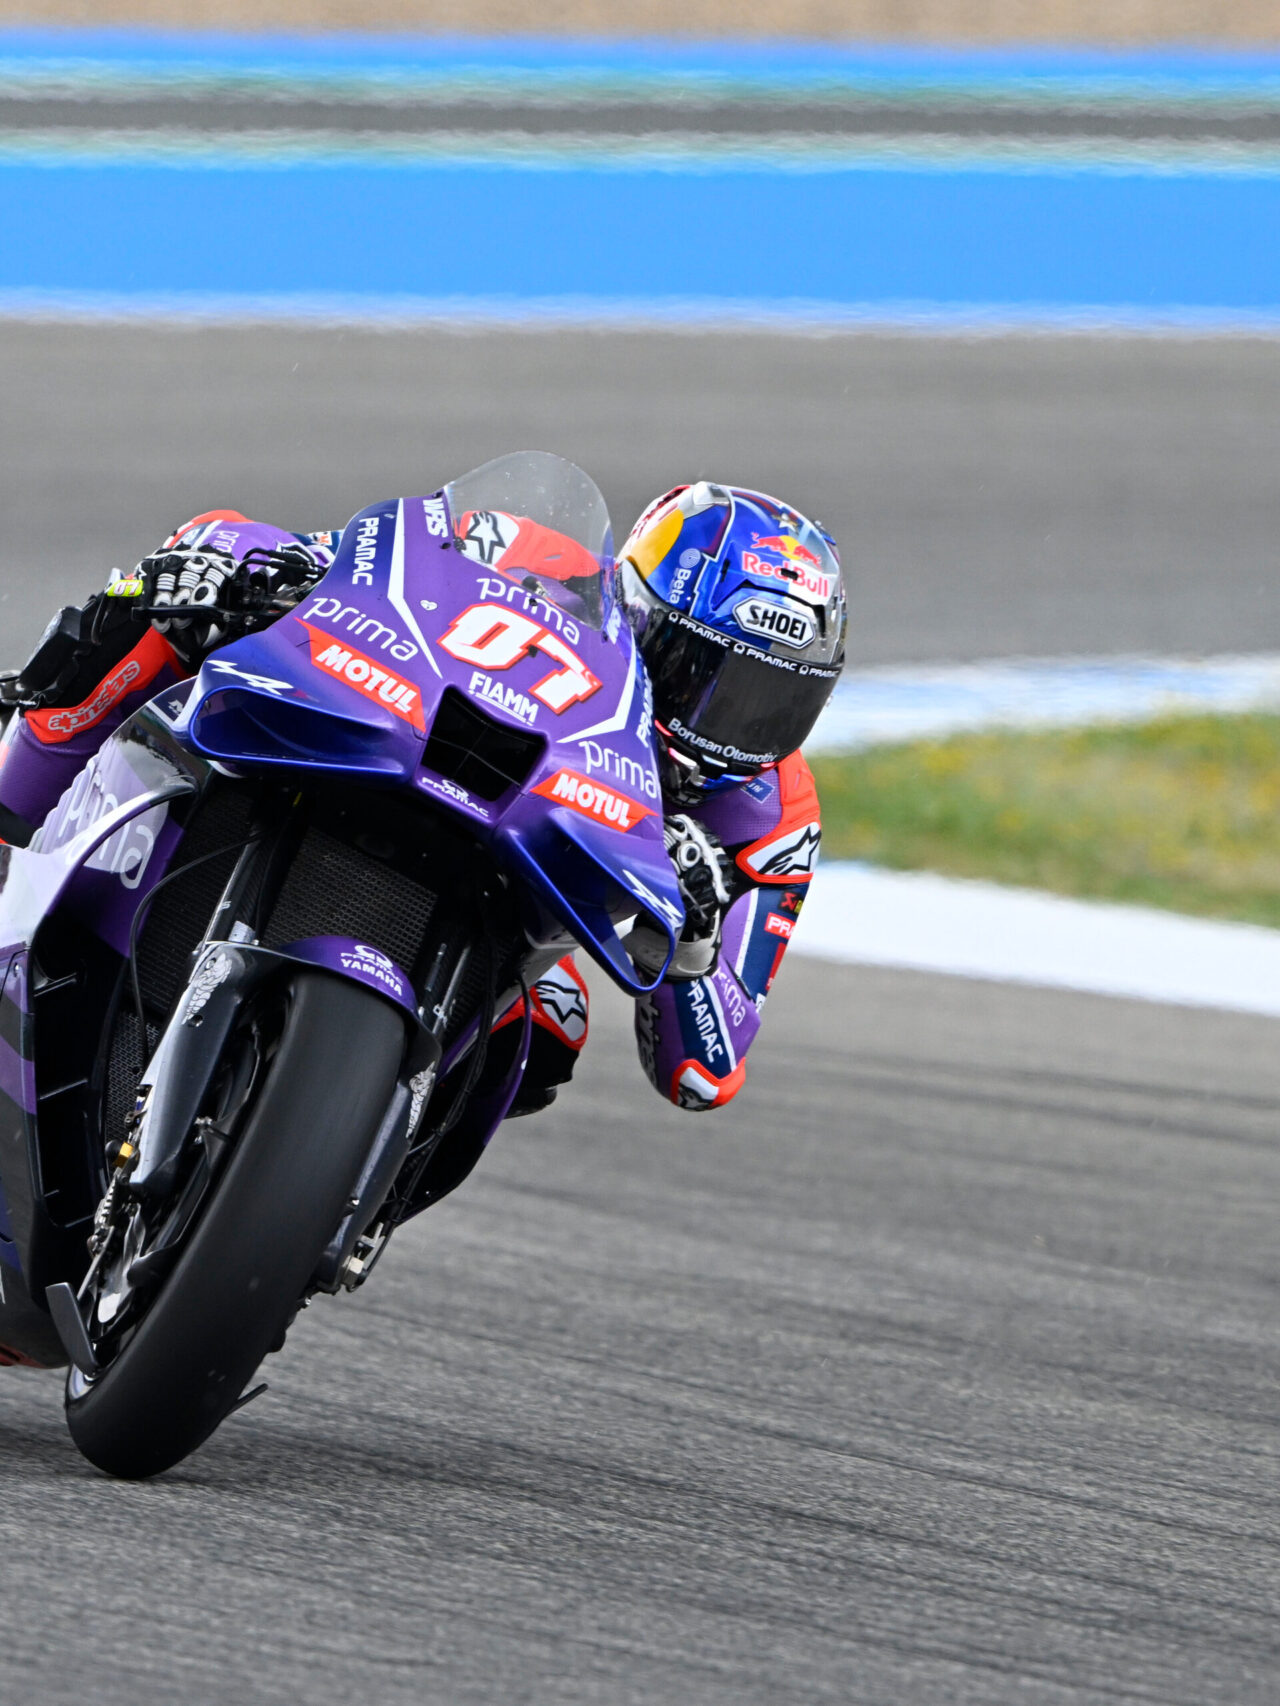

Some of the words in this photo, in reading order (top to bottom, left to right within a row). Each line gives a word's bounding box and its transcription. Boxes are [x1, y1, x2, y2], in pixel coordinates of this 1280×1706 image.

[423, 497, 448, 538] WRS
[352, 517, 380, 586] PRAMAC
[742, 551, 788, 581] Red
[792, 564, 830, 598] Bull
[476, 578, 580, 645] prima
[670, 568, 692, 604] Beta
[303, 597, 419, 661] prima
[679, 617, 731, 648] PRAMAC
[746, 647, 798, 672] PRAMAC
[746, 605, 807, 640] SHOEI
[315, 644, 417, 713] MOTUL
[437, 602, 603, 716] 07
[470, 671, 540, 724] FIAMM
[668, 717, 722, 753] Borusan
[723, 745, 779, 764] Otomotiv
[422, 776, 489, 818] PRAMAC
[579, 741, 658, 798] prima
[551, 773, 632, 828] MOTUL
[341, 958, 403, 996] YAMAHA
[712, 966, 746, 1027] rima
